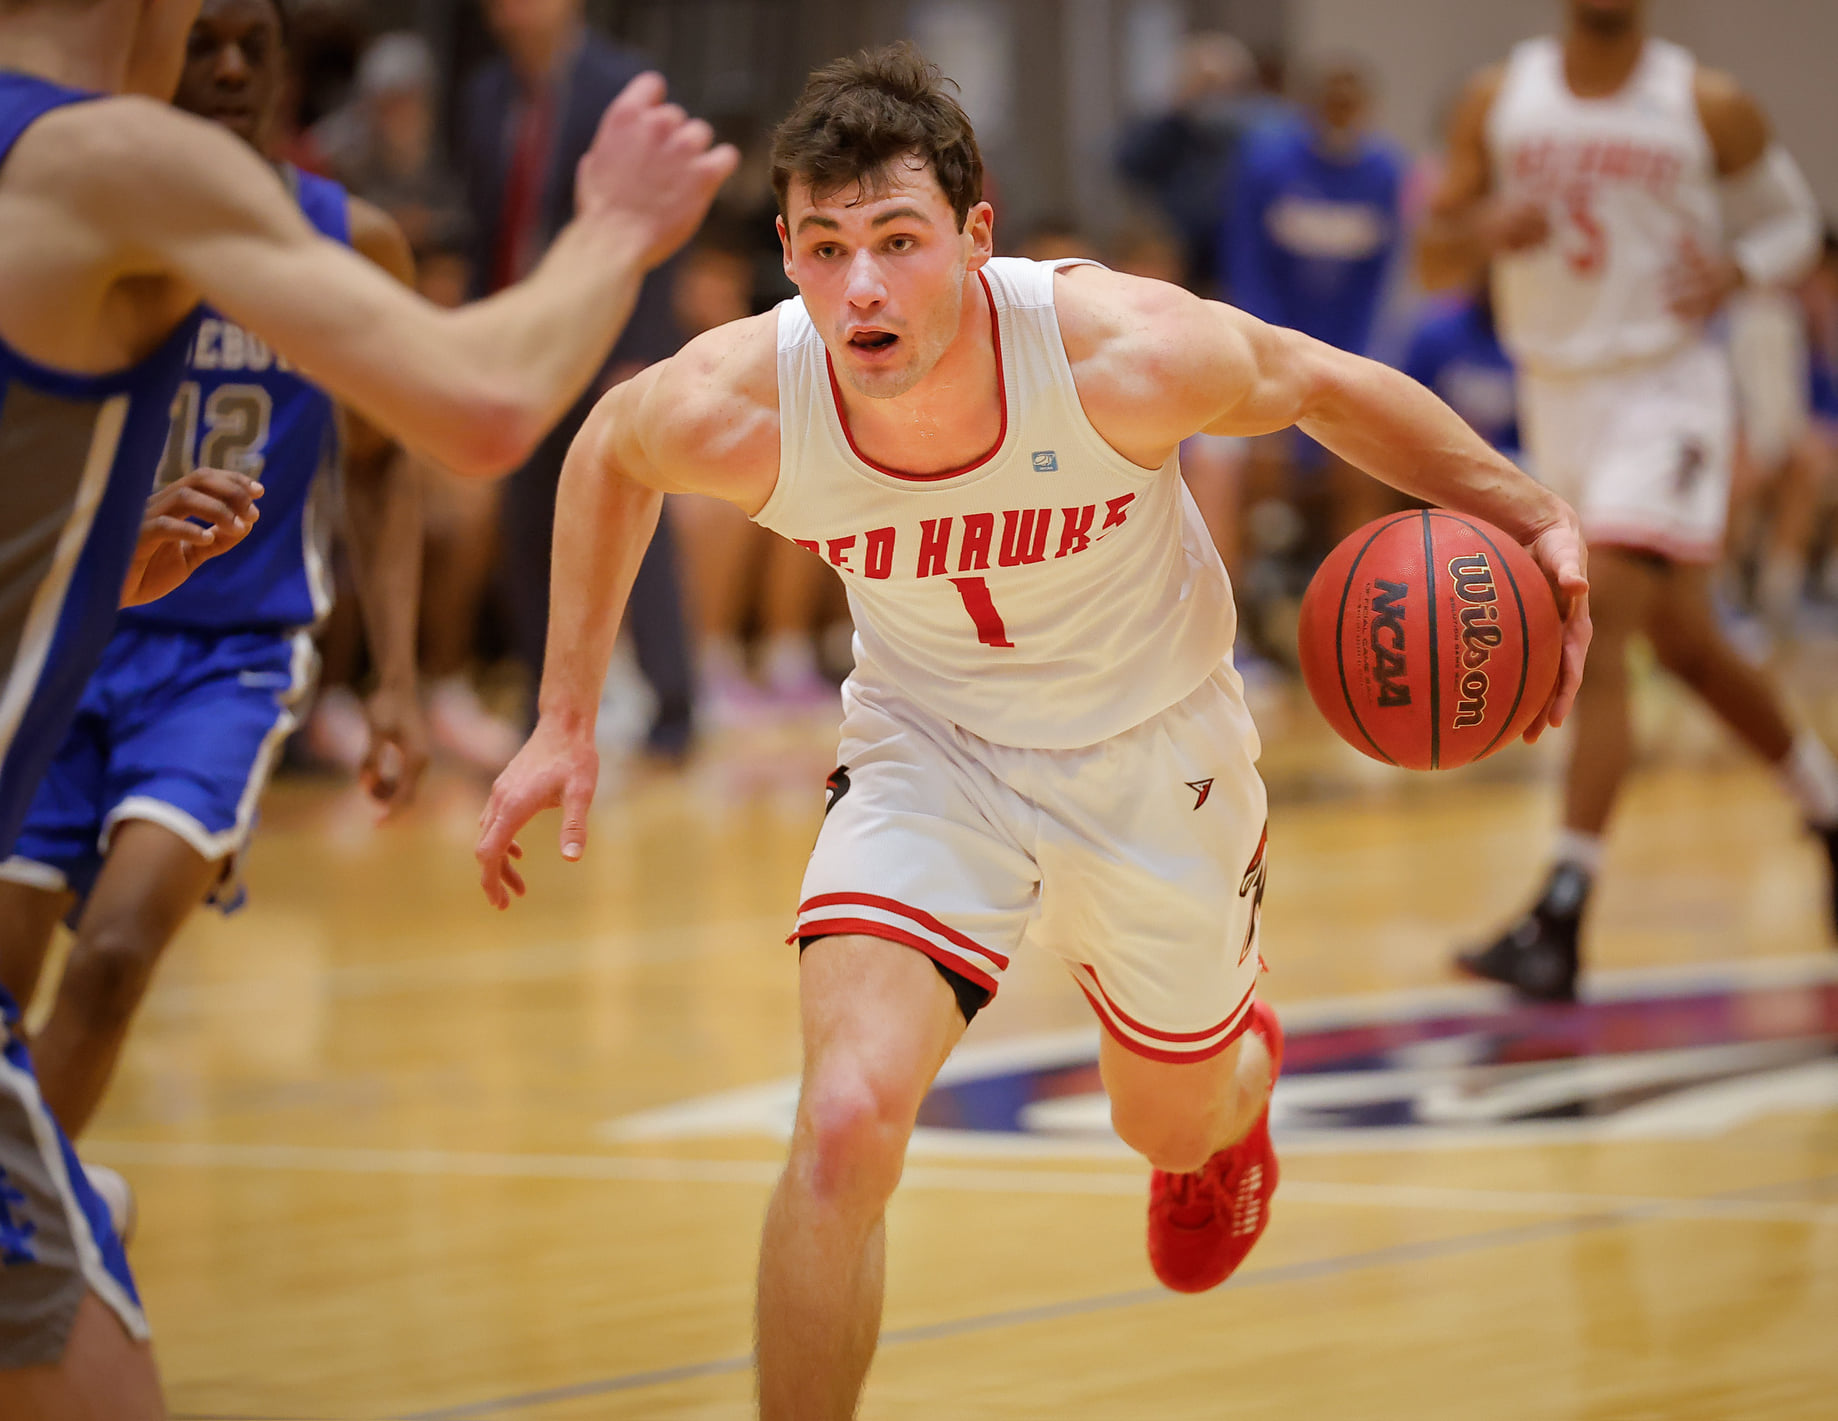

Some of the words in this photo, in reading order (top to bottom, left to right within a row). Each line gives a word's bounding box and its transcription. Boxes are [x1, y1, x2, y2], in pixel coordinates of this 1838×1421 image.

[152, 381, 273, 492] 12
[946, 577, 1015, 648] 1
[1370, 578, 1412, 707] NCAA
[1448, 553, 1503, 729] Wilson
